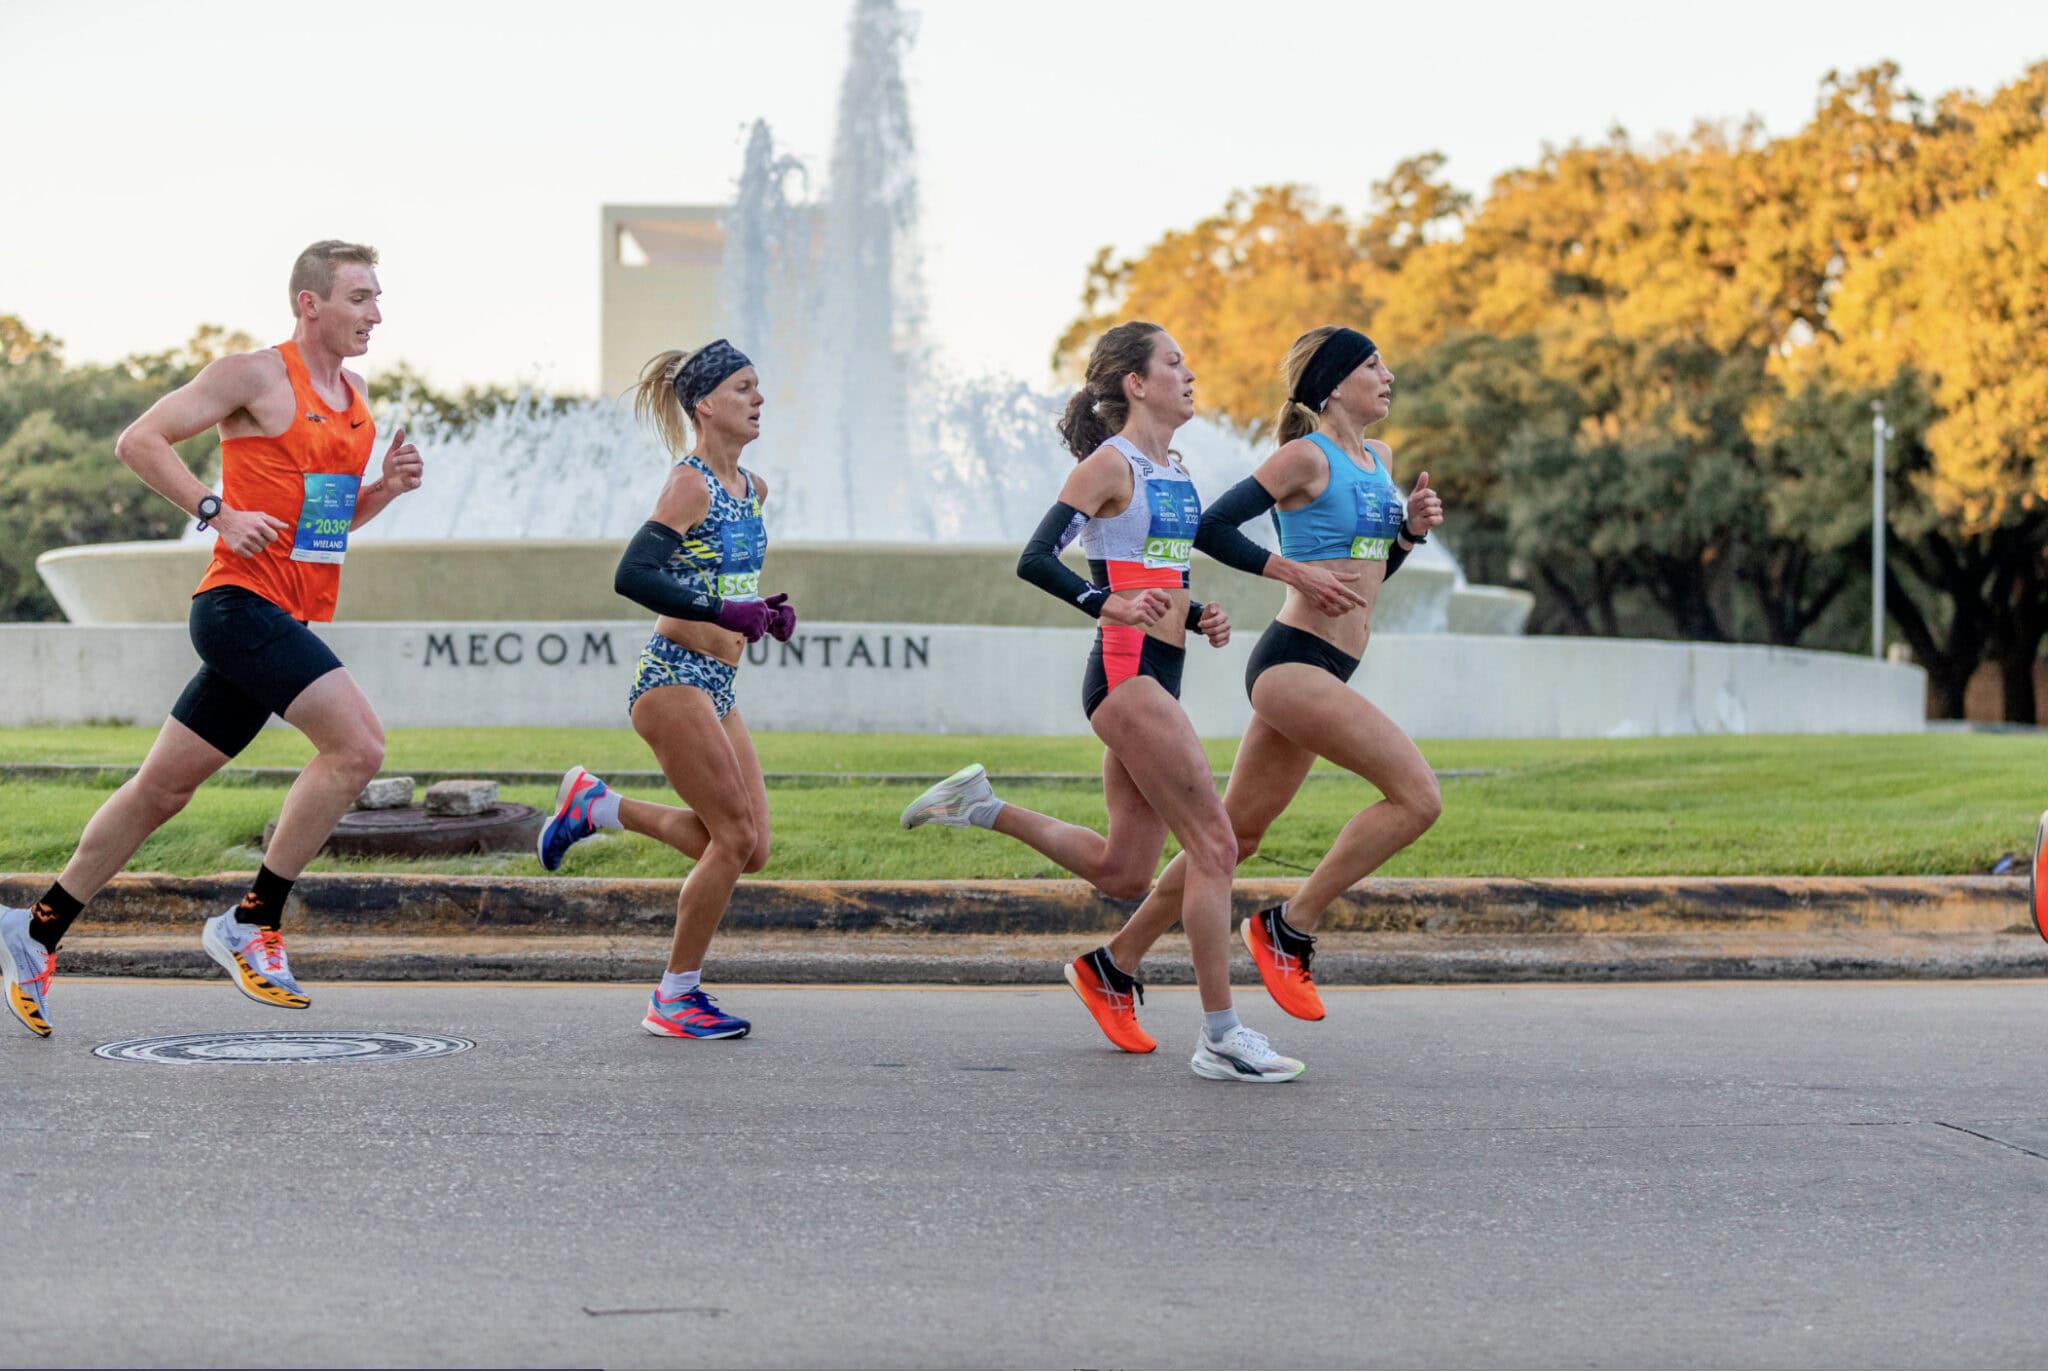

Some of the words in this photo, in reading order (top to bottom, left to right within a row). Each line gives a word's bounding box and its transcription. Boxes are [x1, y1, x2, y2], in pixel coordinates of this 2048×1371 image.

[313, 539, 344, 549] WIELAND
[424, 632, 617, 666] MECOM
[746, 635, 930, 668] UNTAIN
